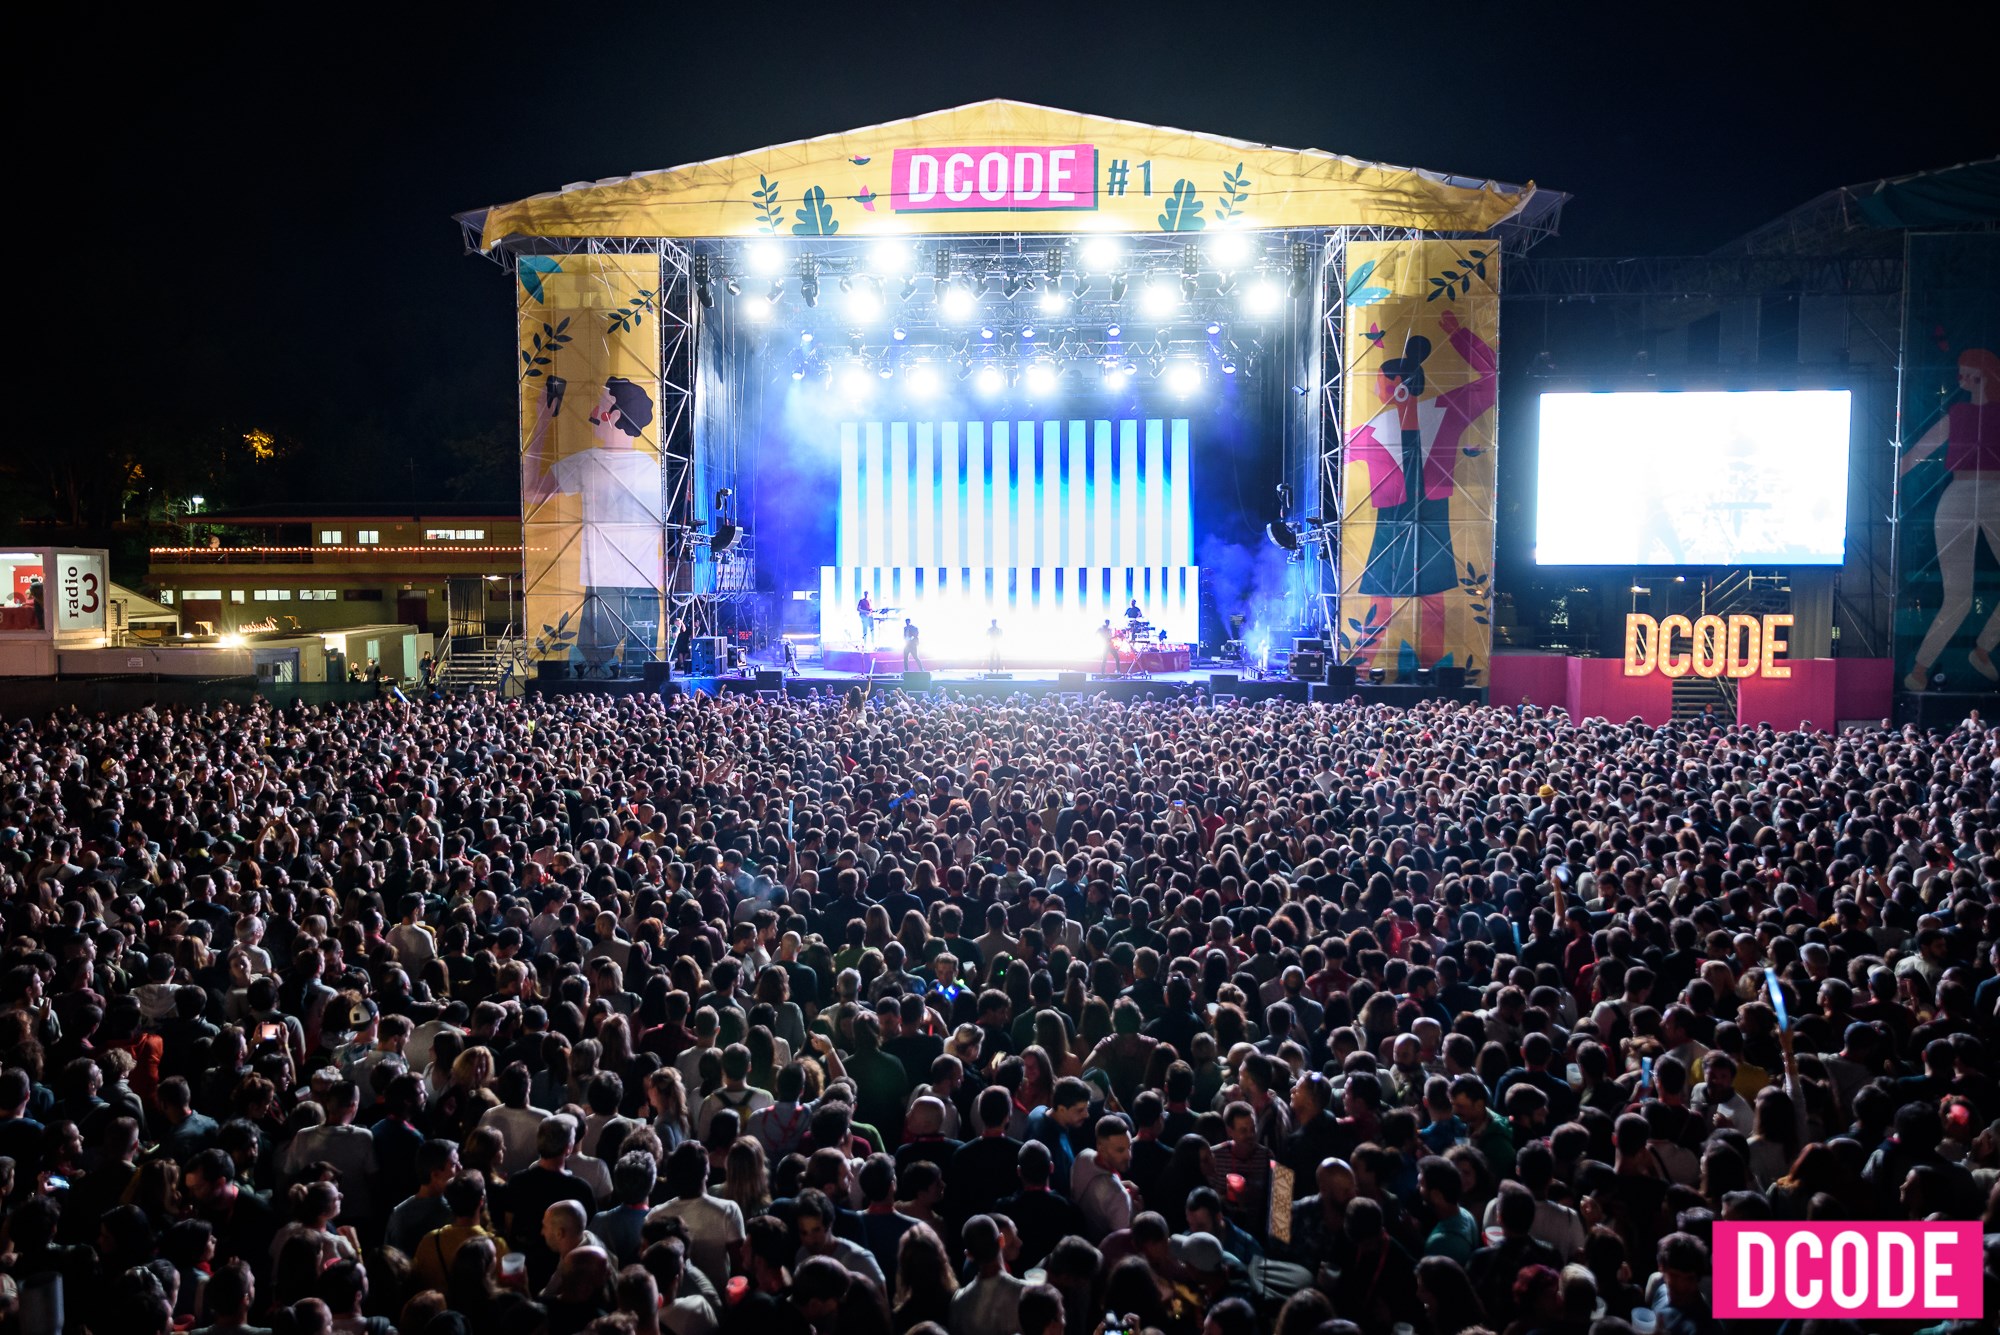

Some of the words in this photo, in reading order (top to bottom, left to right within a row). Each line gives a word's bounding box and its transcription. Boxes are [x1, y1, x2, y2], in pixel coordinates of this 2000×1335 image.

[909, 149, 1075, 202] DCODE
[1107, 160, 1152, 196] #1
[65, 566, 78, 618] radio
[82, 573, 98, 613] 3
[1624, 613, 1794, 678] DCODE
